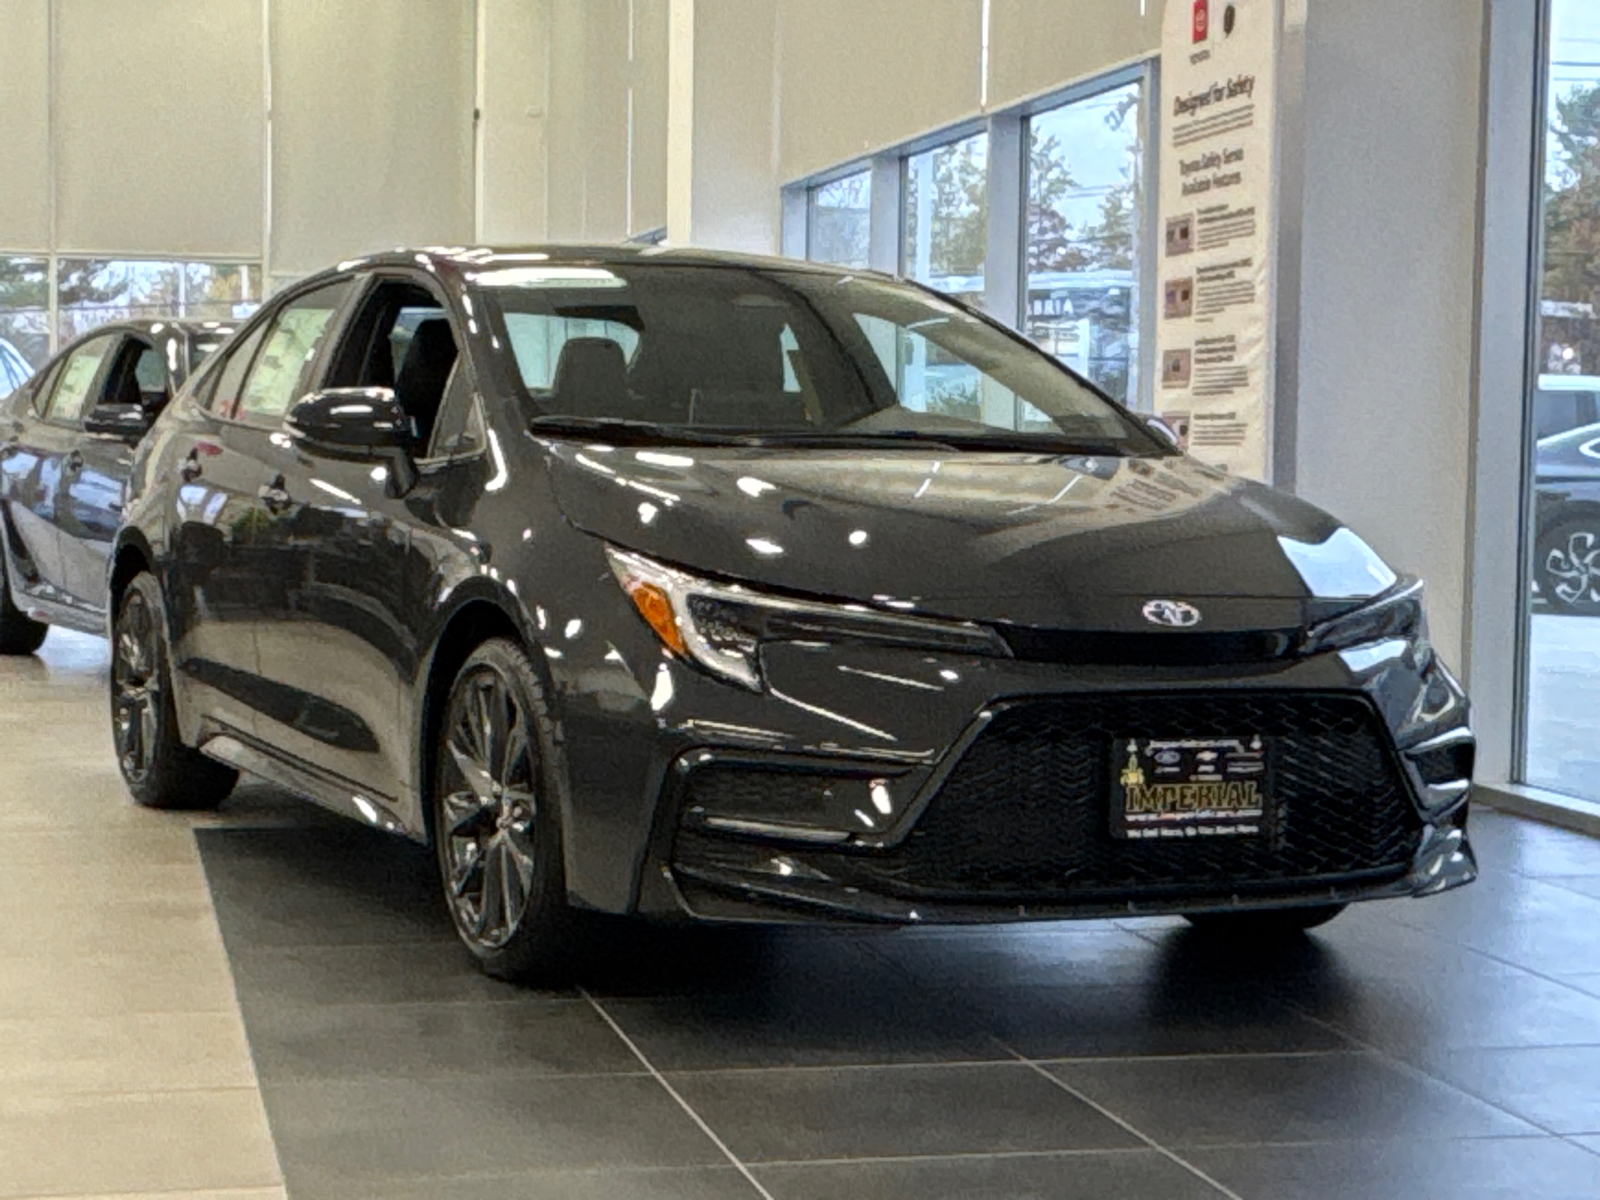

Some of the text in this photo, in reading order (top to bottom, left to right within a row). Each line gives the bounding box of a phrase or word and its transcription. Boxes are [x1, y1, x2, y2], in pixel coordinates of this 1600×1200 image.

[1174, 89, 1211, 117] Designed
[1226, 74, 1256, 99] Safety
[1028, 299, 1074, 316] BRIA
[1125, 781, 1263, 813] IMPERIAL
